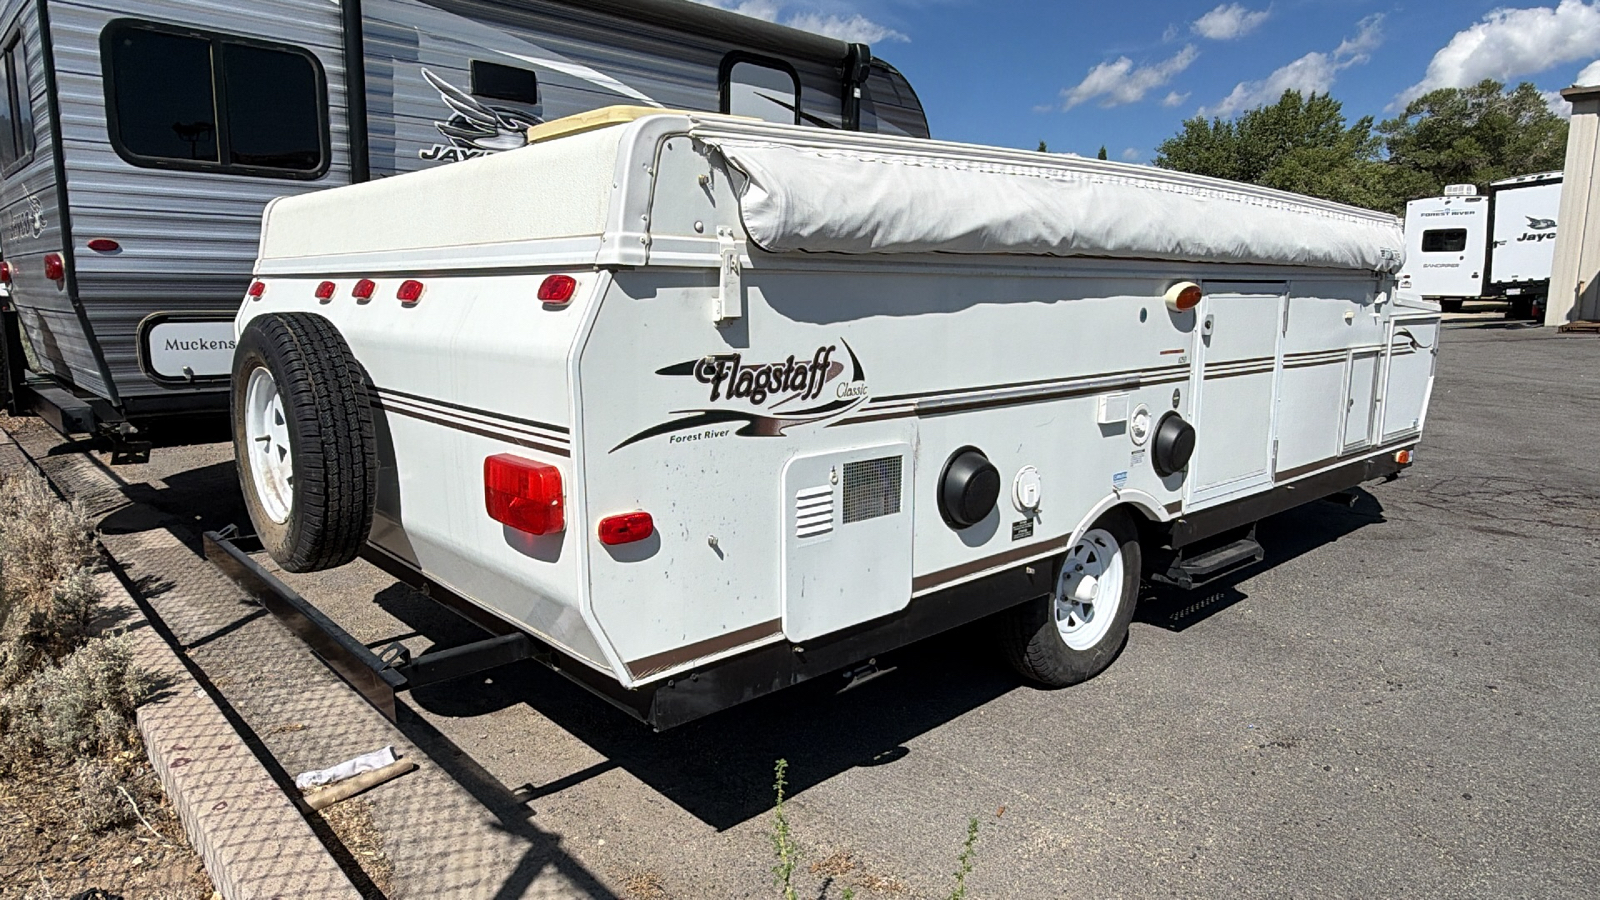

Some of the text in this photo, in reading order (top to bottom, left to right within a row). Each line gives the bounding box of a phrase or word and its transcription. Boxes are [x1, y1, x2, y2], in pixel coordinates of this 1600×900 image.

[694, 345, 836, 405] Flagstaff
[836, 381, 868, 399] Classic
[669, 430, 730, 444] Forest River
